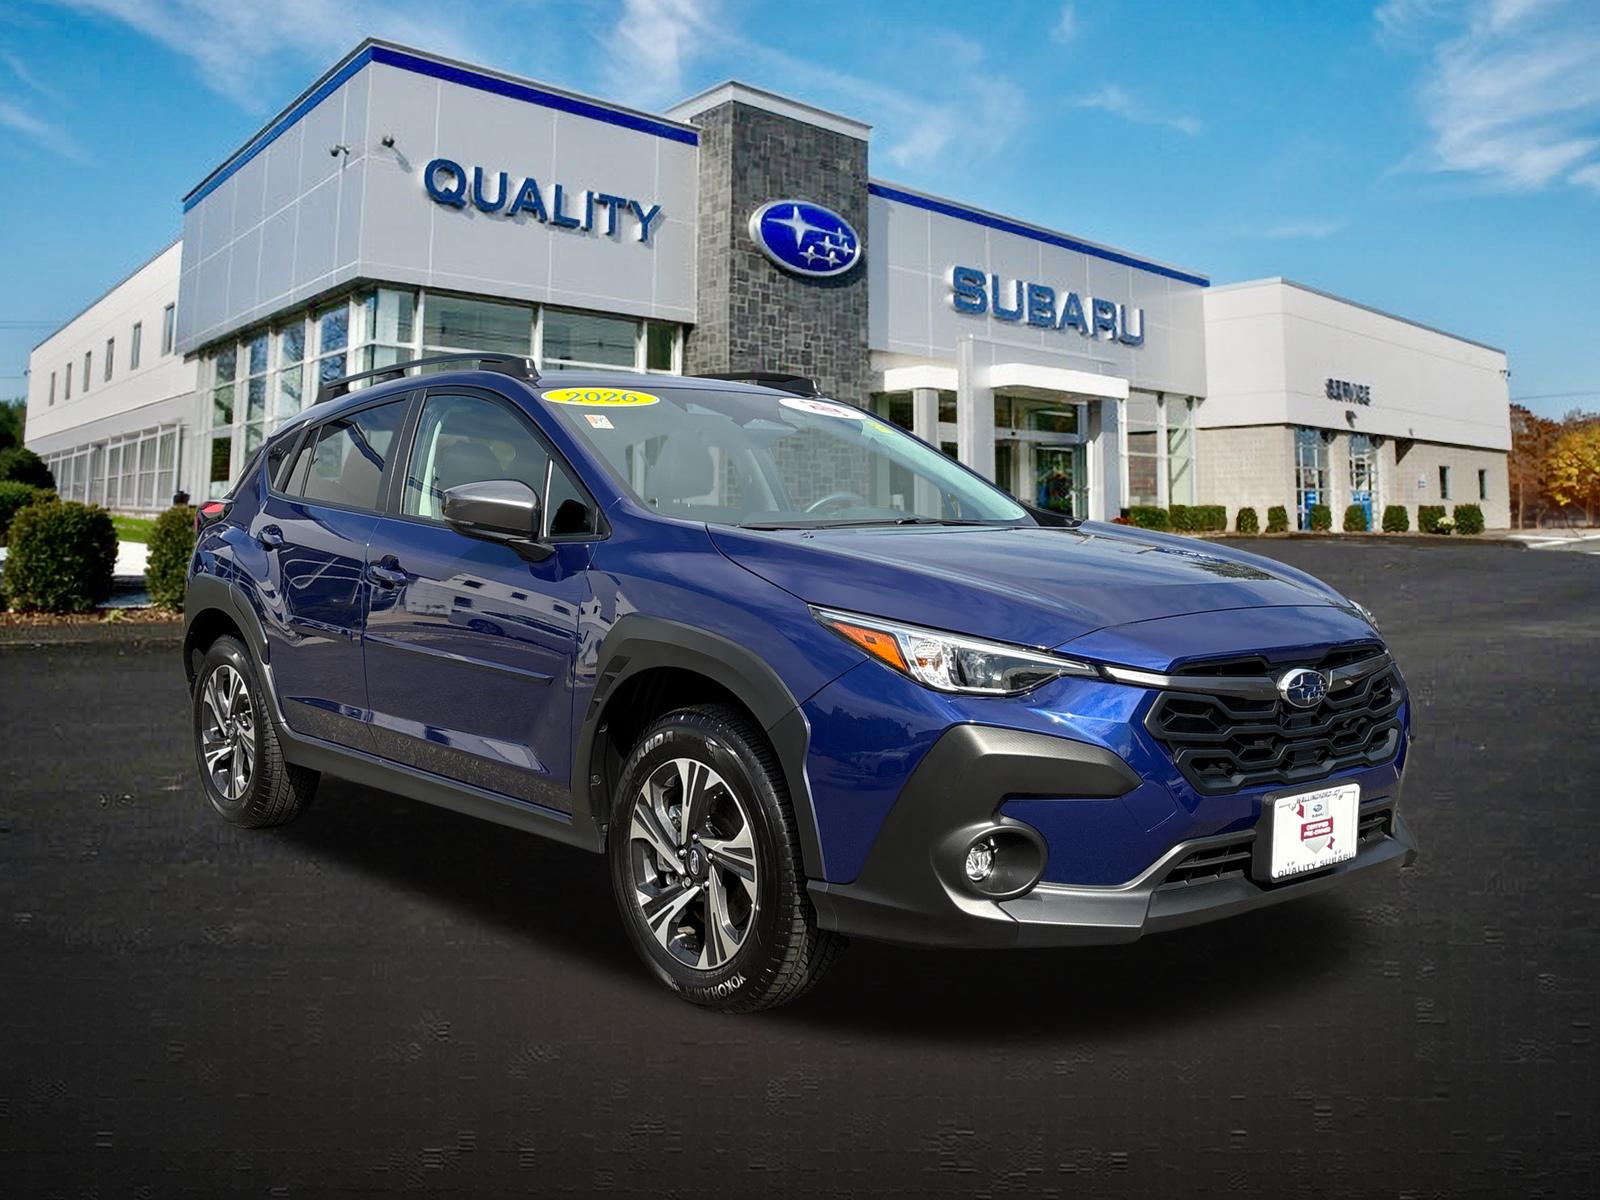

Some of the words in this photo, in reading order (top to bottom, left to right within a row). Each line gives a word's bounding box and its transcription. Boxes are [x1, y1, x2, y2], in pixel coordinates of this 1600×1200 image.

[424, 158, 661, 242] QUALITY
[952, 266, 1145, 347] SUBARU
[566, 391, 638, 402] 2026
[1325, 378, 1371, 407] SERVICE
[1278, 861, 1317, 877] QUALITY
[1320, 852, 1355, 867] SUBARU
